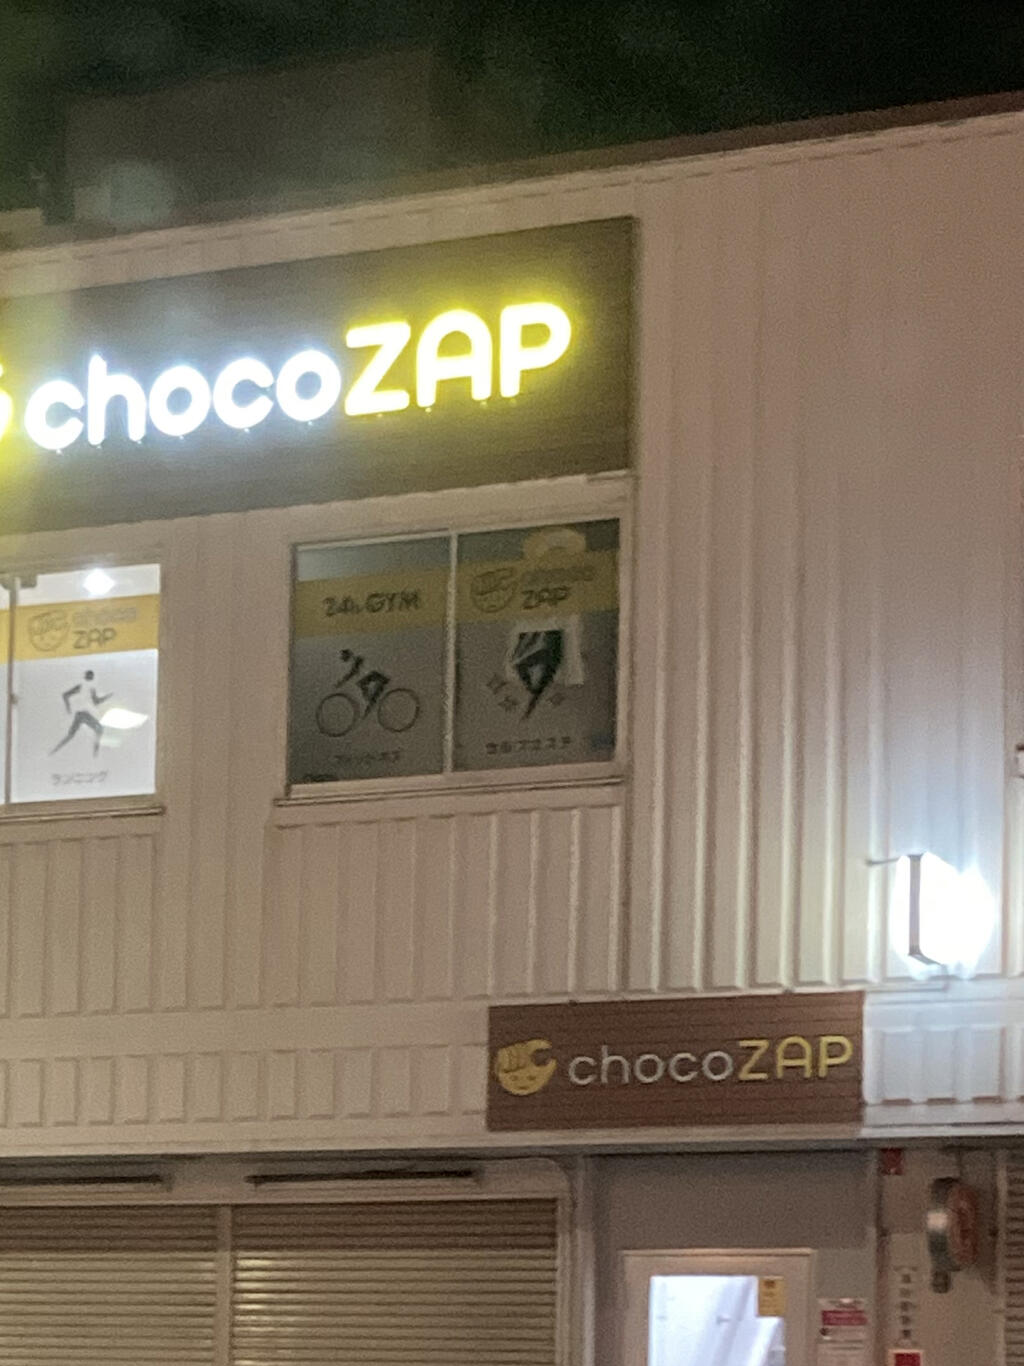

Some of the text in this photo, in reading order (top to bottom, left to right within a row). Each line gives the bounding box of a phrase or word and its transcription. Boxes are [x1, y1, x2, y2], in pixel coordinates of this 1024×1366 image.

[23, 301, 573, 451] chocoZAP
[364, 589, 422, 614] GYM
[568, 1036, 854, 1086] chocoZAP
